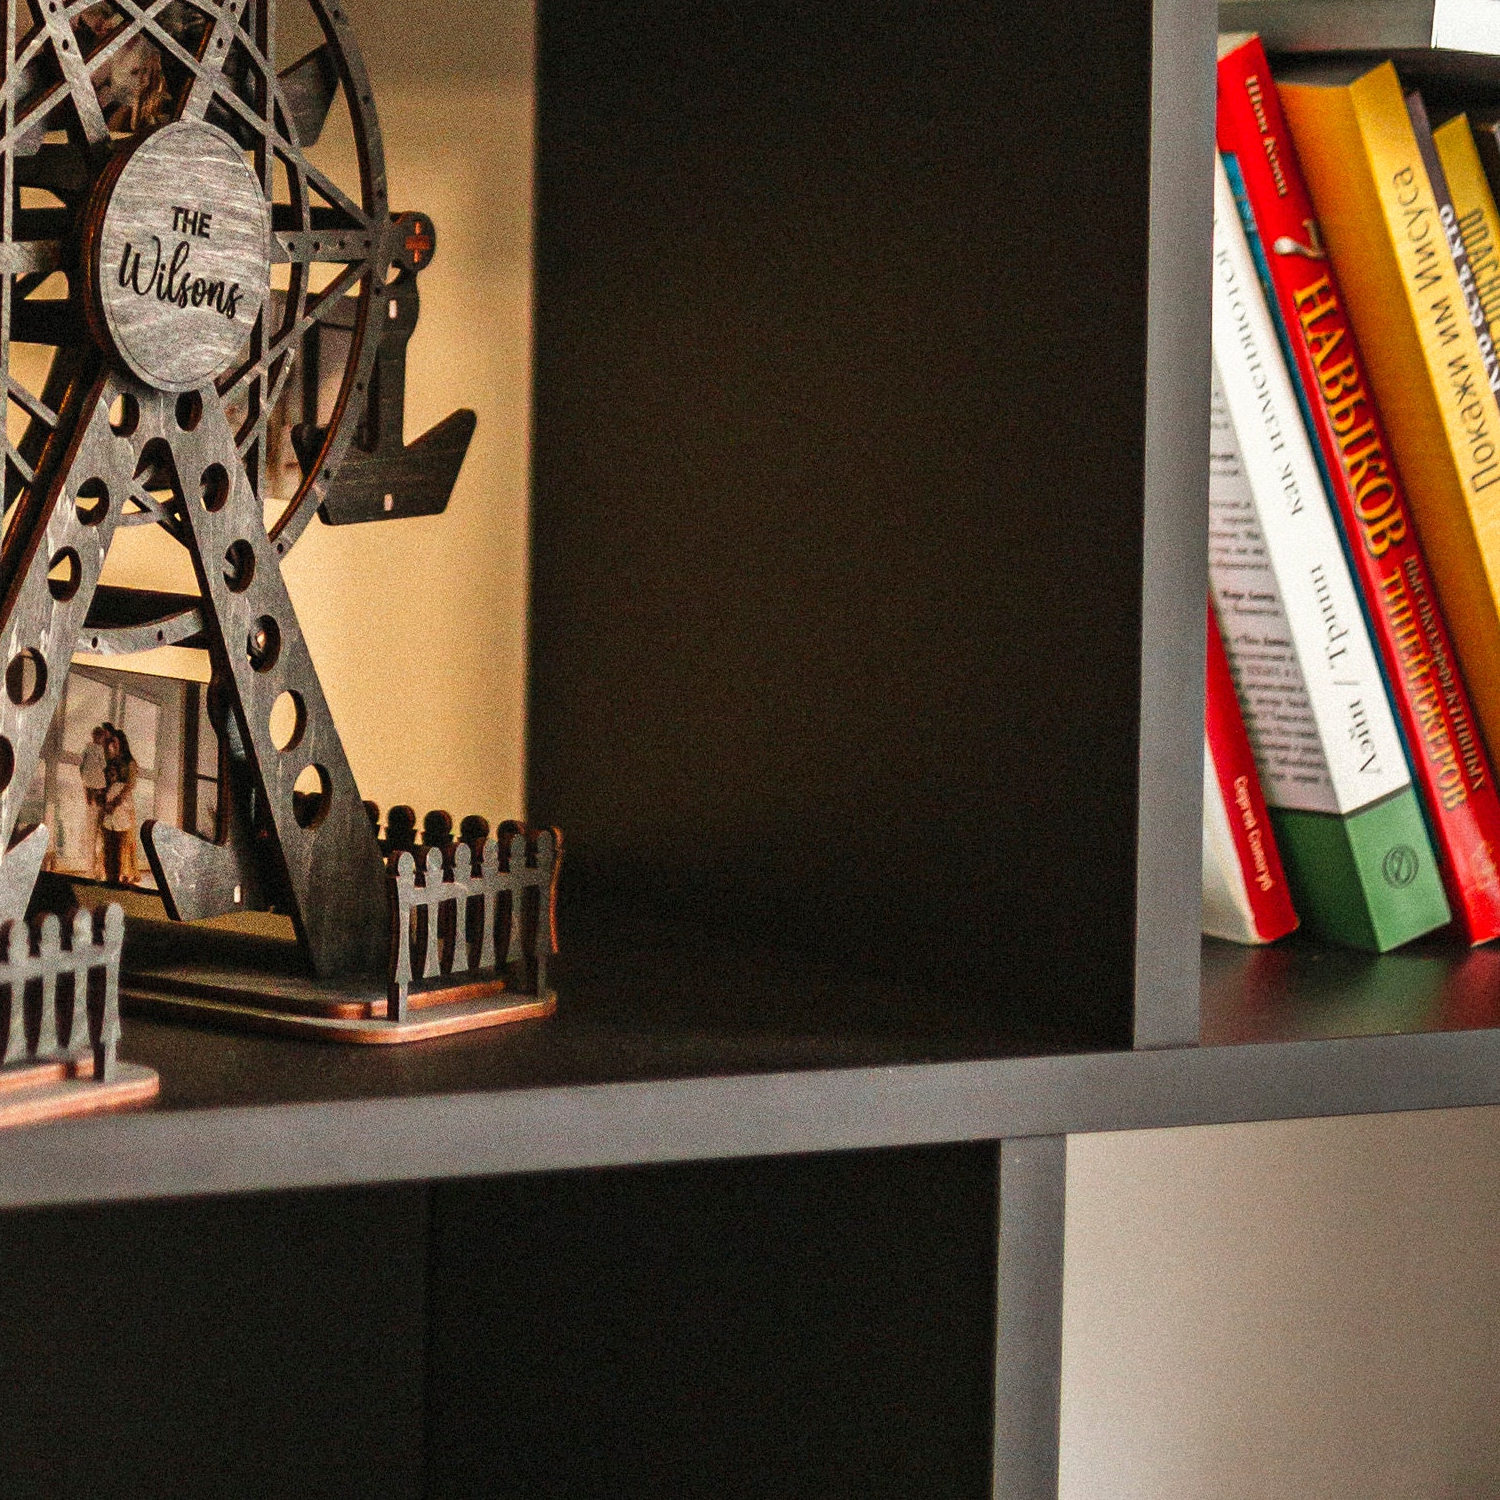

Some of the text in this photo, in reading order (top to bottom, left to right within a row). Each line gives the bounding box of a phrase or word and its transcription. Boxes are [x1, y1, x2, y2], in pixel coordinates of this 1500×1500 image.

[119, 235, 243, 319] Wilsons
[171, 206, 213, 239] THE
[1273, 218, 1408, 559] 7 НАВЫКОВ
[1392, 167, 1498, 494] Покажи им Иисуса
[1349, 698, 1384, 776] Лэйн
[1380, 568, 1467, 811] ТИНЕЙДЖЕРОВ
